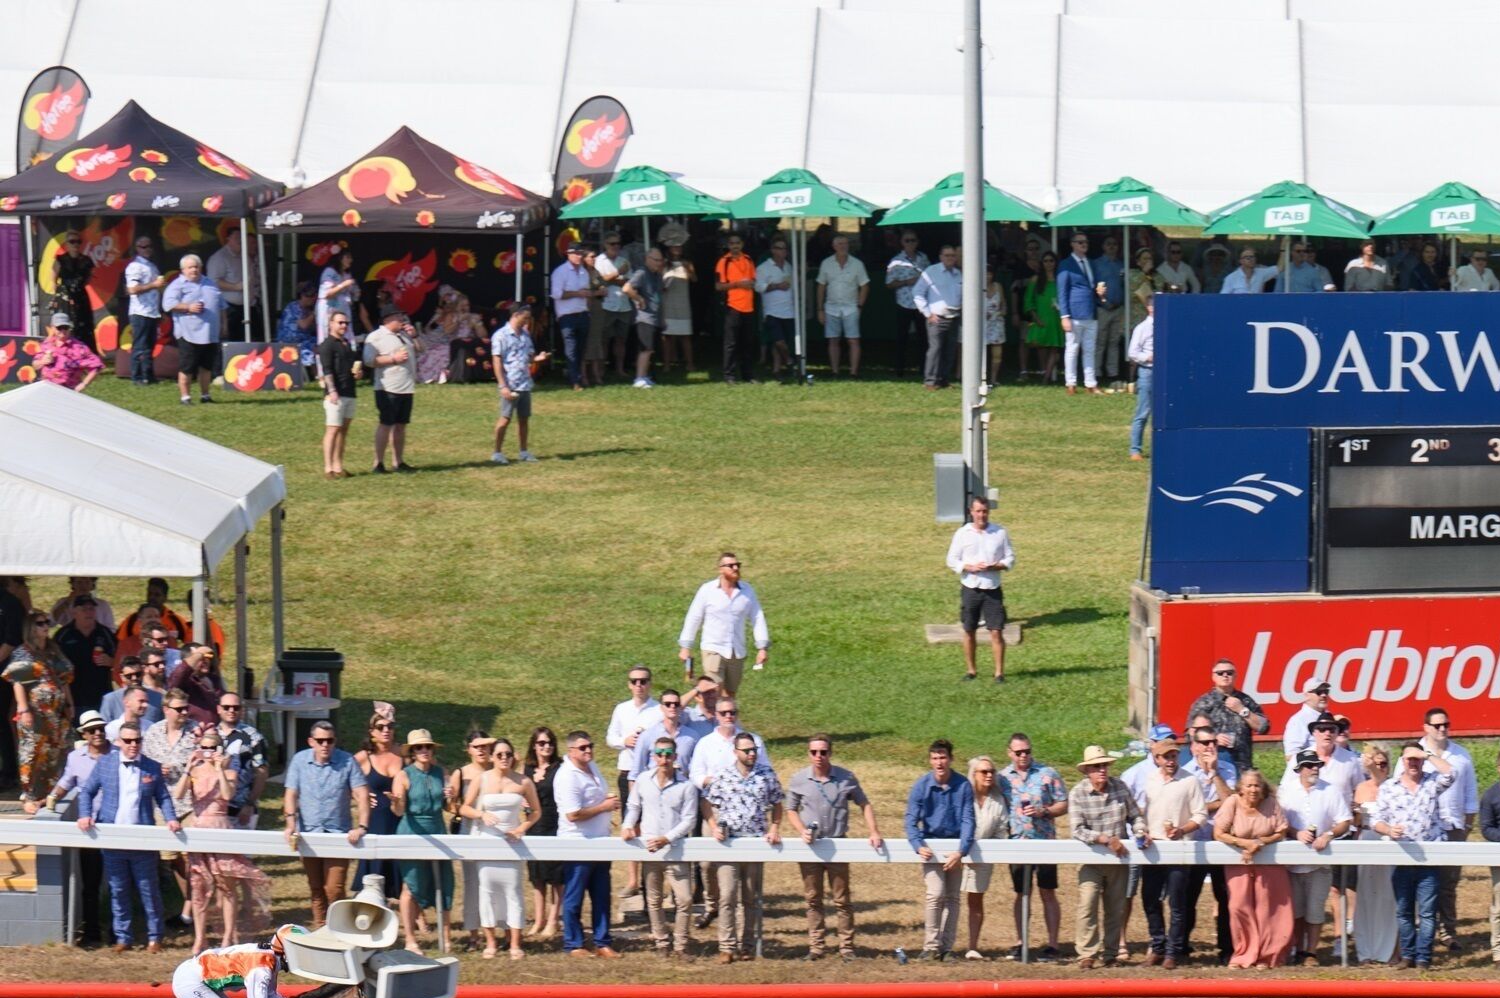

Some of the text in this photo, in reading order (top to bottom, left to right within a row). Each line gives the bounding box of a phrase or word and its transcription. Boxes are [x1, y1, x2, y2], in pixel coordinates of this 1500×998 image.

[626, 192, 661, 203] TAB
[773, 195, 807, 206] TAB
[1110, 202, 1144, 213] TAB
[1272, 210, 1304, 221] TAB
[1436, 211, 1470, 220] TAB
[1339, 437, 1370, 463] 1ST
[1411, 438, 1450, 463] 2ND
